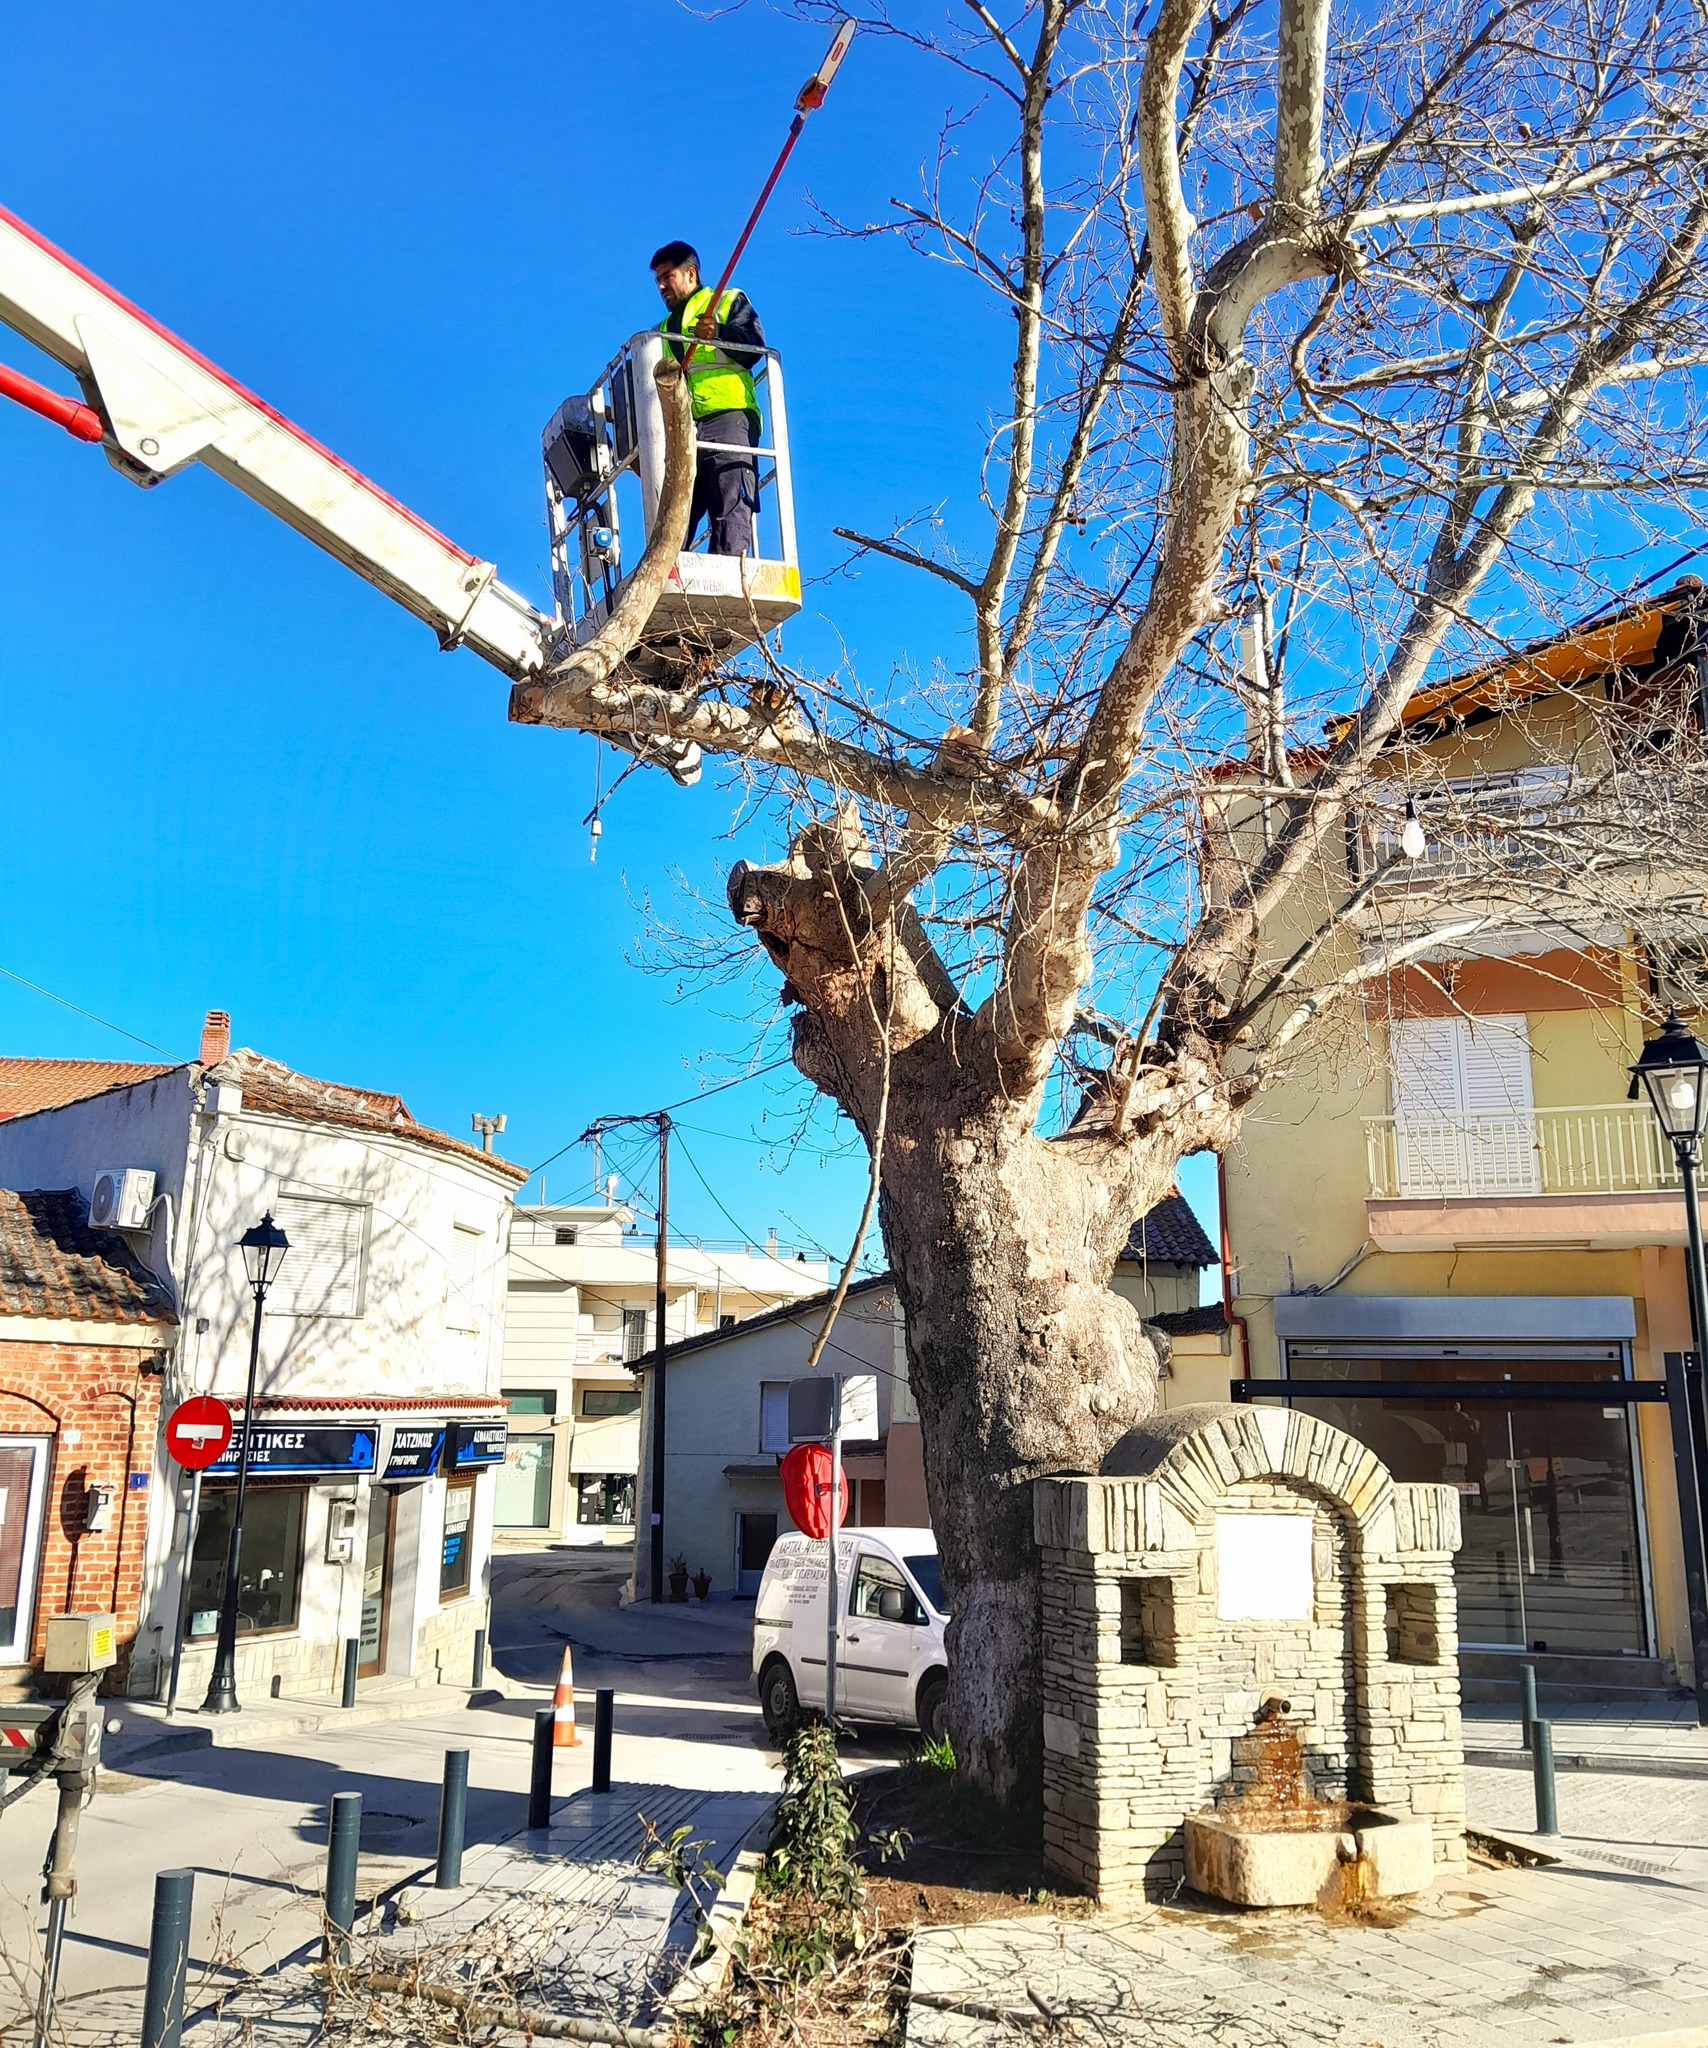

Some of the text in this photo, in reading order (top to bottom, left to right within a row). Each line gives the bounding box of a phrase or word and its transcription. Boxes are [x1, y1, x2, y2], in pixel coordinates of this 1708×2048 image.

[227, 1433, 306, 1449] ΕΣΙΤΙΚΕΣ
[394, 1432, 434, 1449] ΧΑΤΖΙΚΟΣ
[87, 1721, 100, 1756] 2
